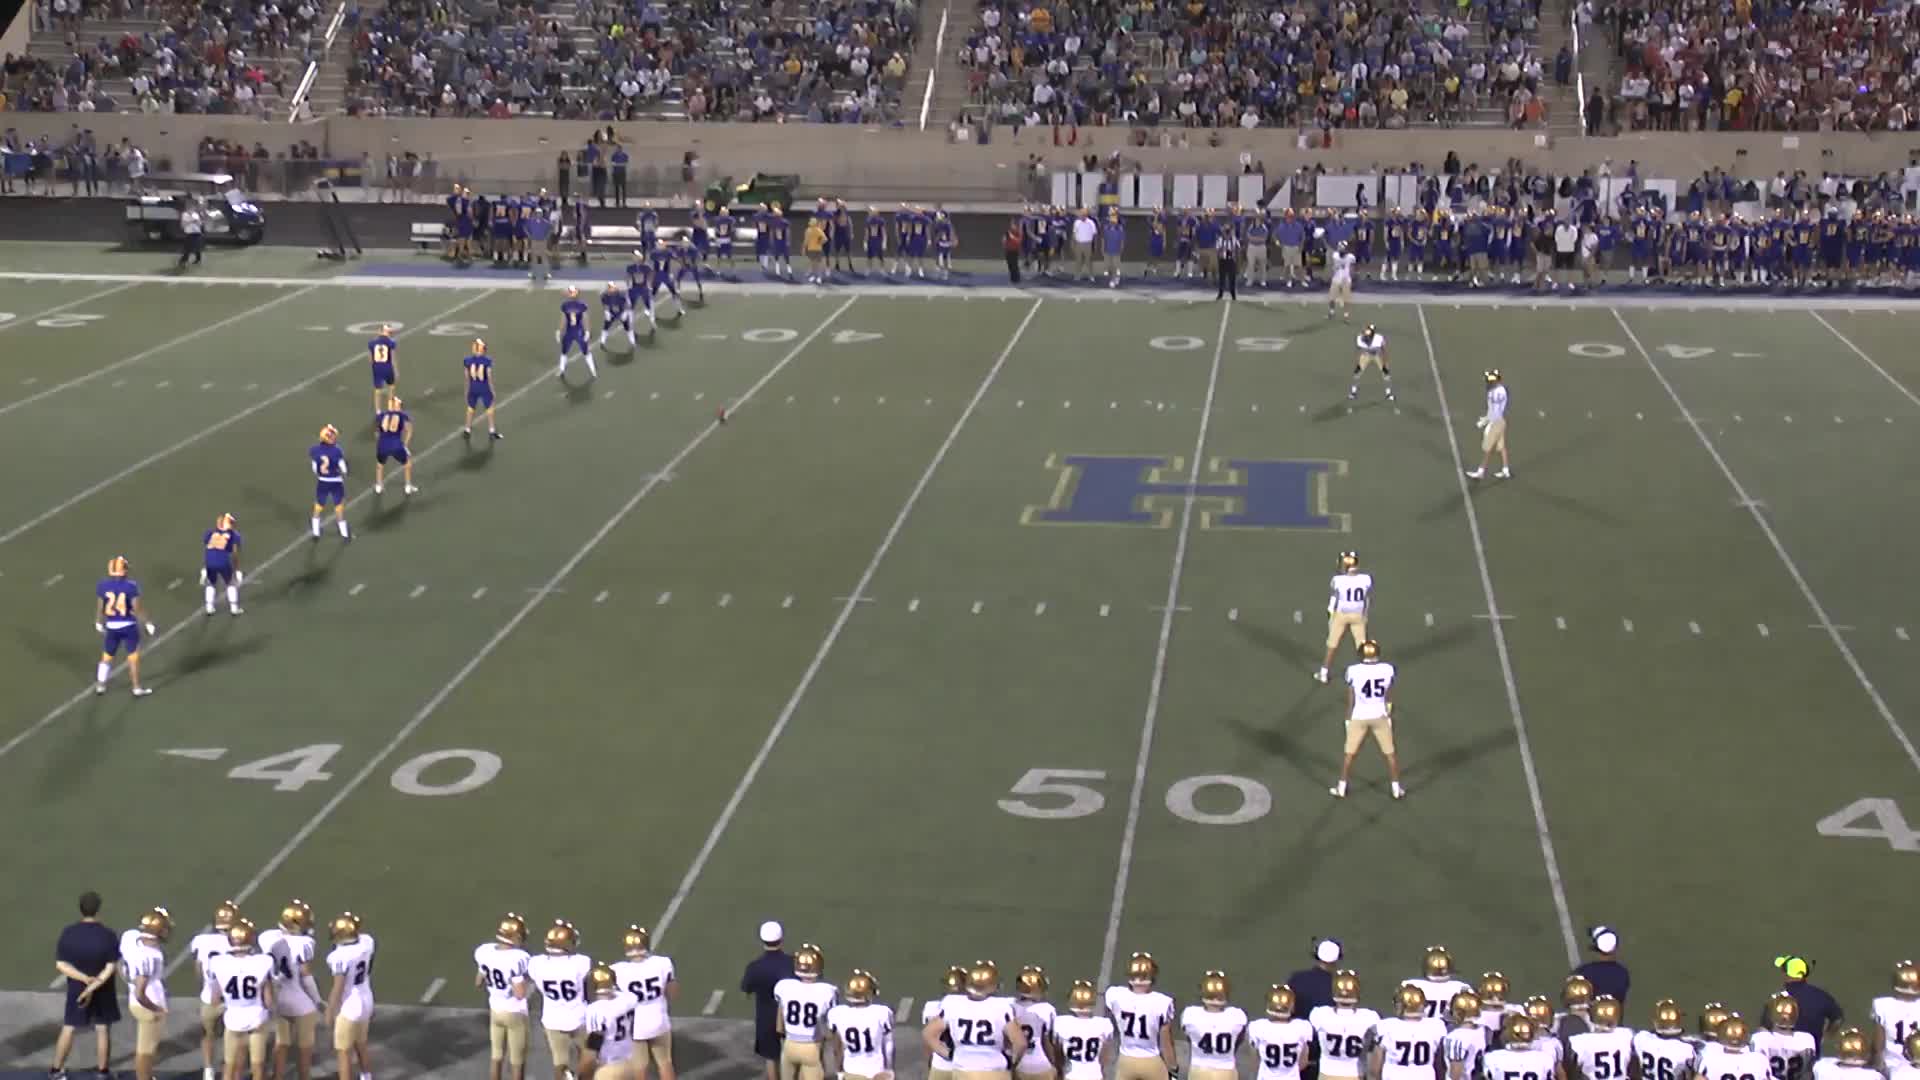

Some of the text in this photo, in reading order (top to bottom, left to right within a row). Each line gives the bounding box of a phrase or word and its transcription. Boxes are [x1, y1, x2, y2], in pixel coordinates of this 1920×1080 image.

[320, 455, 330, 474] 2
[105, 592, 127, 616] 24
[1346, 587, 1364, 602] 10
[1361, 678, 1386, 698] 45
[225, 975, 258, 1000] 46
[542, 980, 578, 1001] 56
[786, 1000, 818, 1028] 88
[1120, 1010, 1150, 1040] 71
[845, 1027, 875, 1053] 91
[957, 1018, 996, 1046] 72
[1198, 1032, 1232, 1054] 40
[1066, 1036, 1099, 1062] 28
[1264, 1043, 1299, 1068] 95
[1326, 1034, 1363, 1058] 76
[1395, 1041, 1430, 1066] 70
[1594, 1049, 1622, 1080] 51
